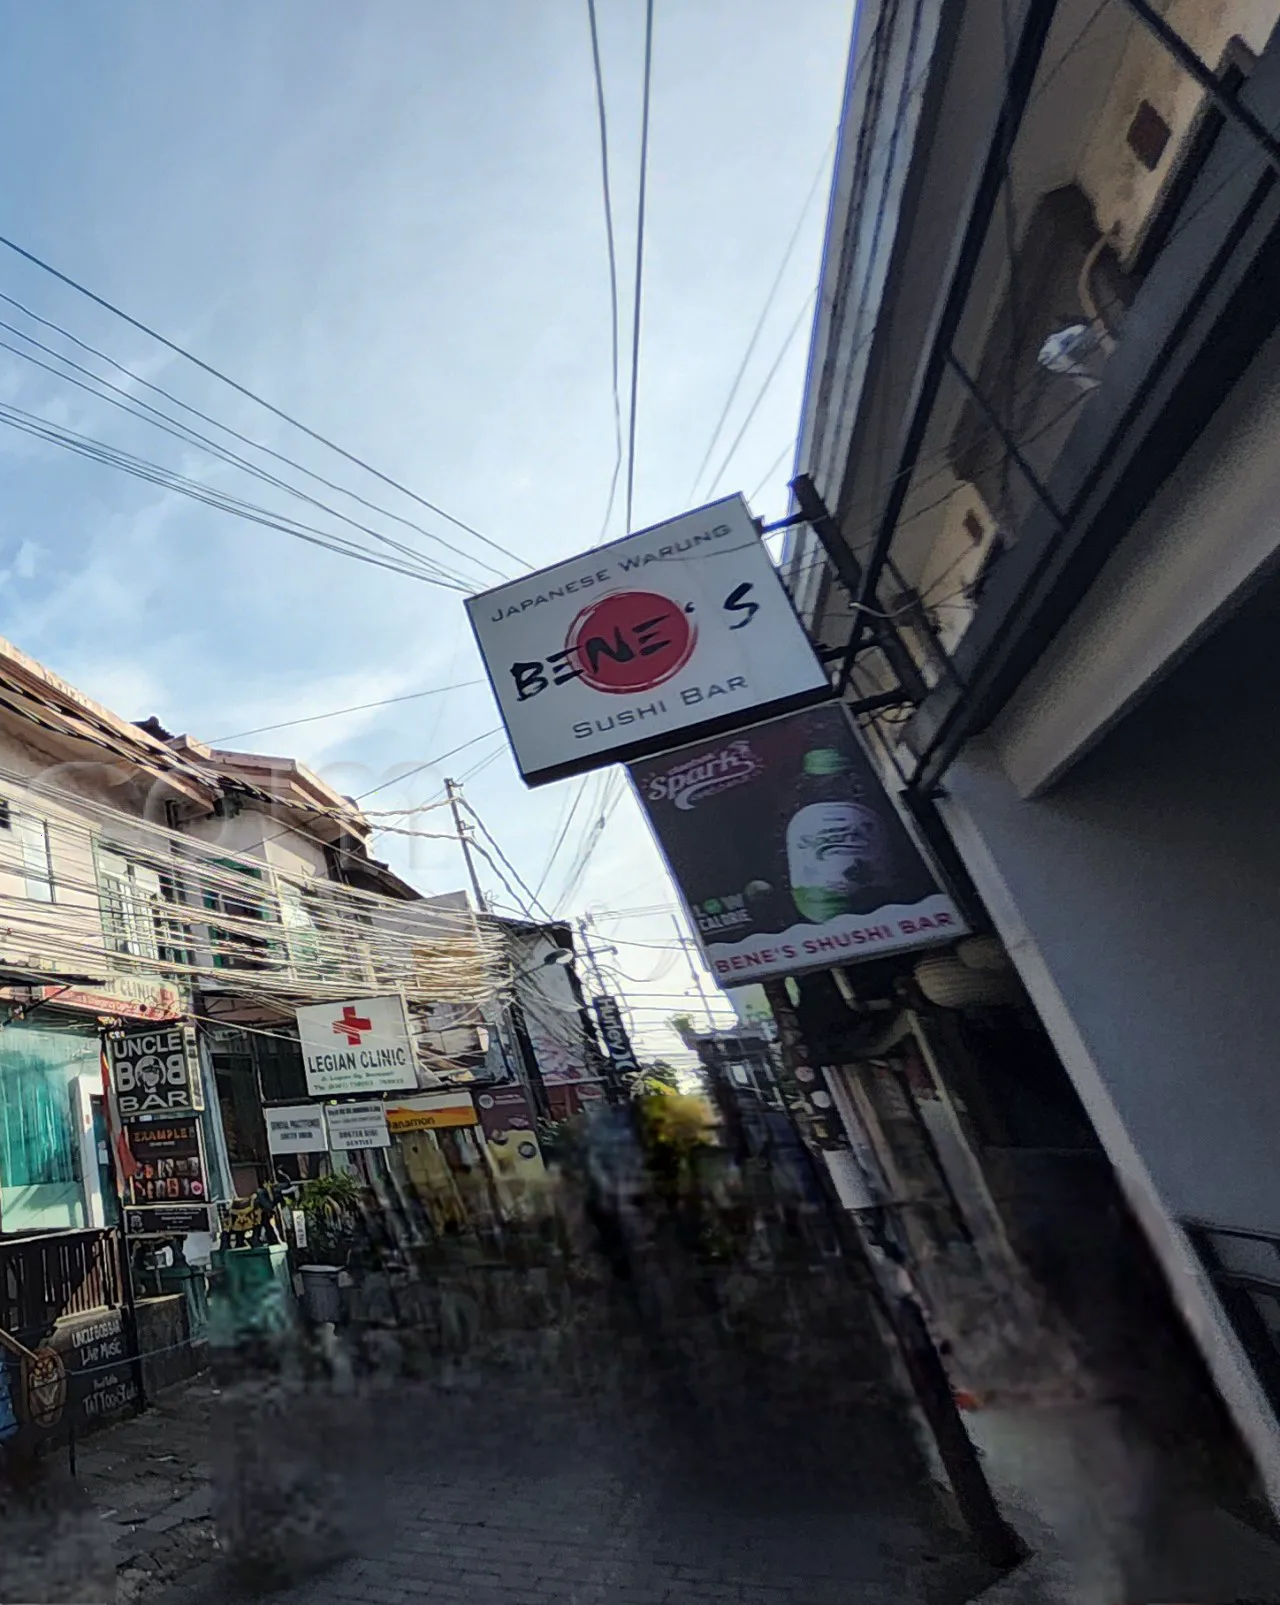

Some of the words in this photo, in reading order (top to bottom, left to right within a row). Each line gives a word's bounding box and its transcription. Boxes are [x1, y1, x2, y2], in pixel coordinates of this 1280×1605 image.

[491, 569, 612, 623] JAPANESE
[618, 524, 732, 572] WARUNG
[573, 700, 667, 740] SUSHI
[714, 946, 797, 974] BENE'S
[802, 924, 894, 955] SHUSHI
[898, 912, 955, 934] BAR
[114, 1031, 182, 1059] UNCLE
[307, 1051, 357, 1074] LEGIAN
[360, 1047, 407, 1069] CLINIC
[119, 1090, 190, 1114] BAR
